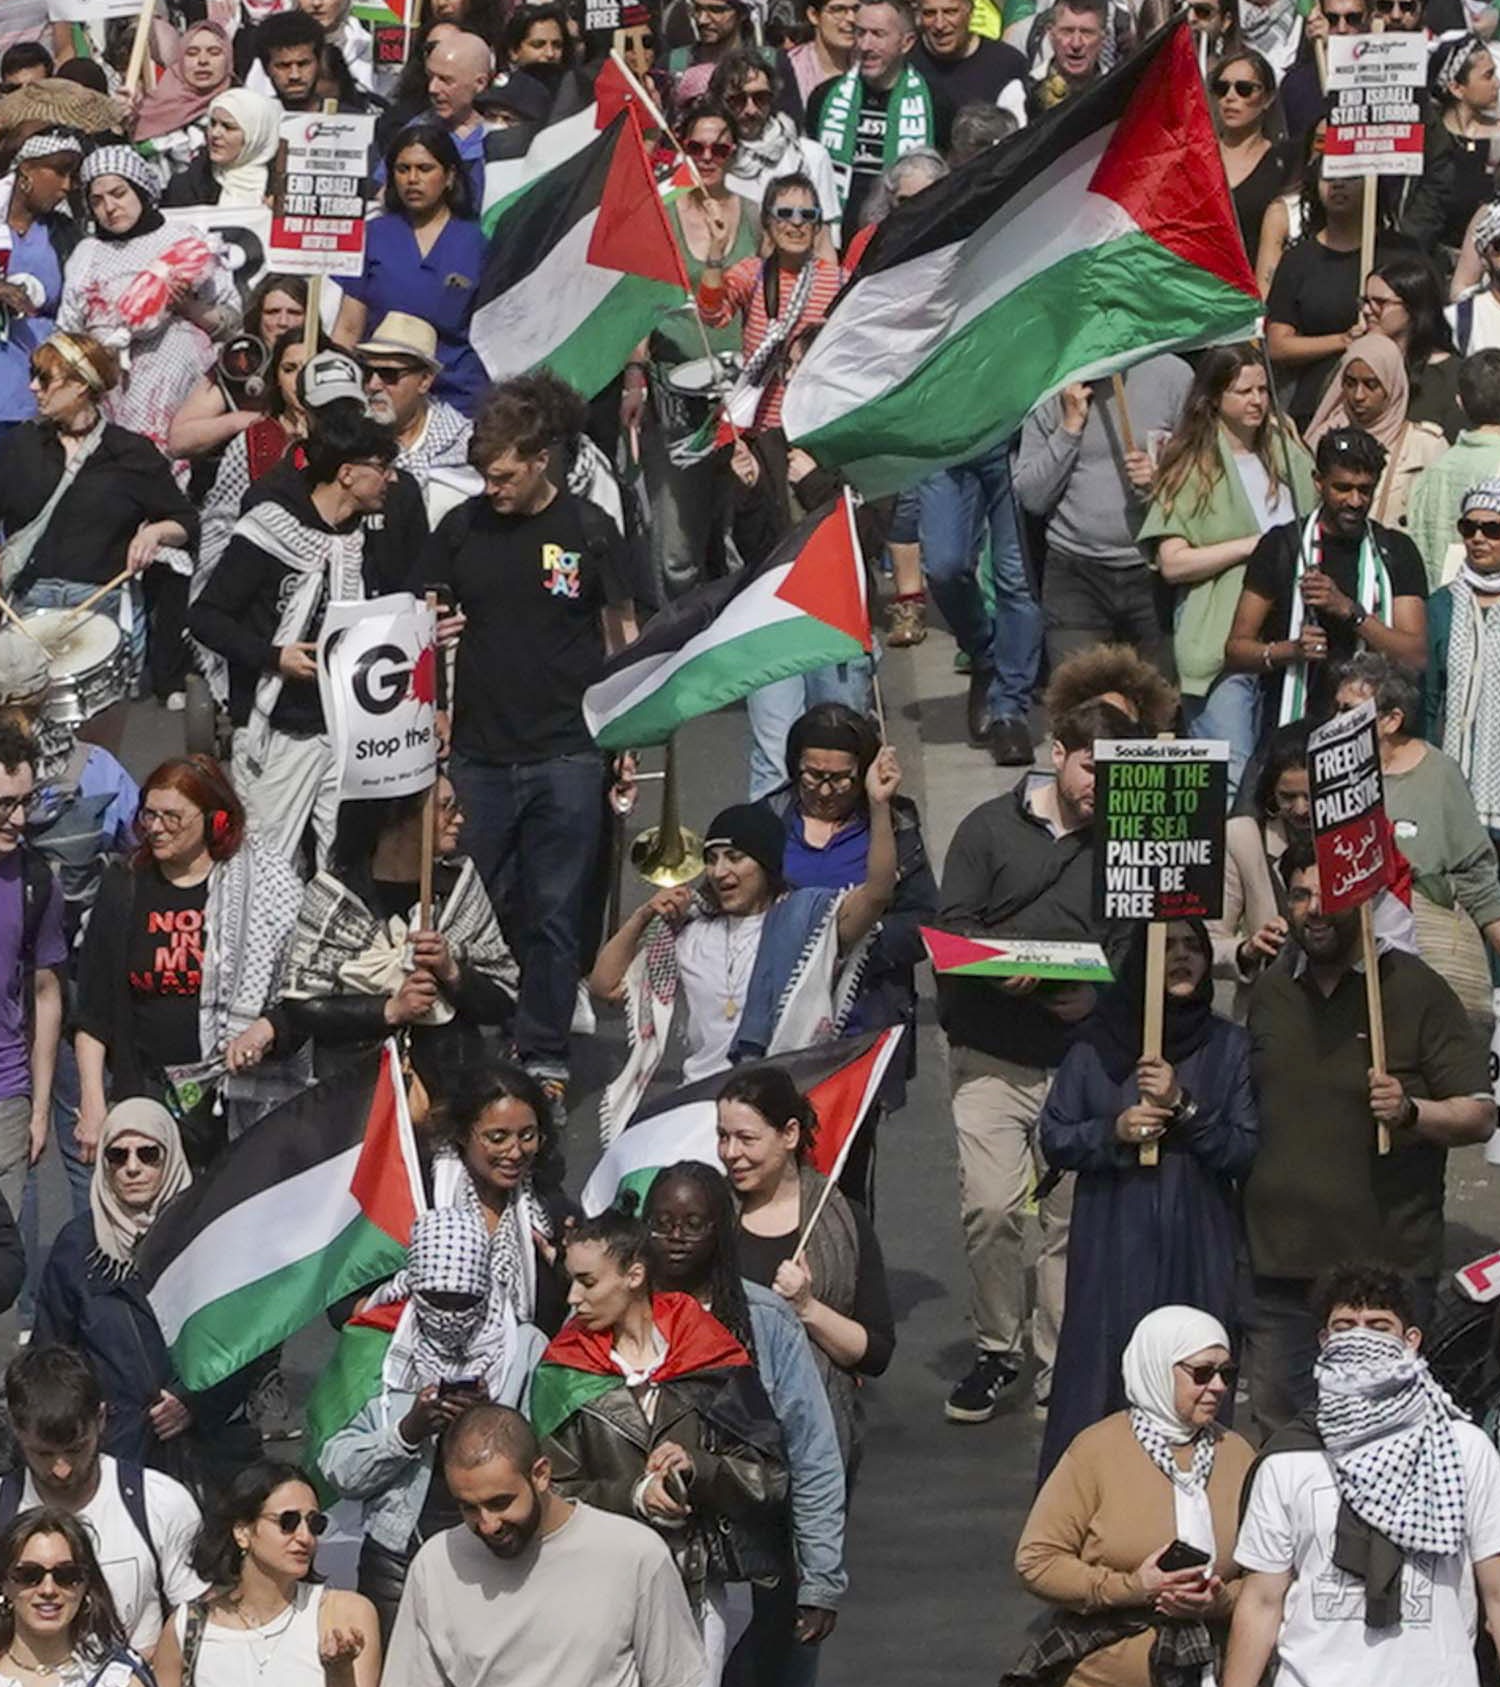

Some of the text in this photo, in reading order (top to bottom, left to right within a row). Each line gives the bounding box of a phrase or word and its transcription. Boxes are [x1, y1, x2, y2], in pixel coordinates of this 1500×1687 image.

[355, 732, 402, 761] Stop
[1108, 764, 1210, 789] FROM THE
[1107, 790, 1199, 815] RIVER TO
[1107, 816, 1189, 840] THE SEA
[1106, 840, 1212, 866] PALESTINE
[1106, 866, 1186, 892] WILL BE
[1105, 891, 1155, 918] FREE
